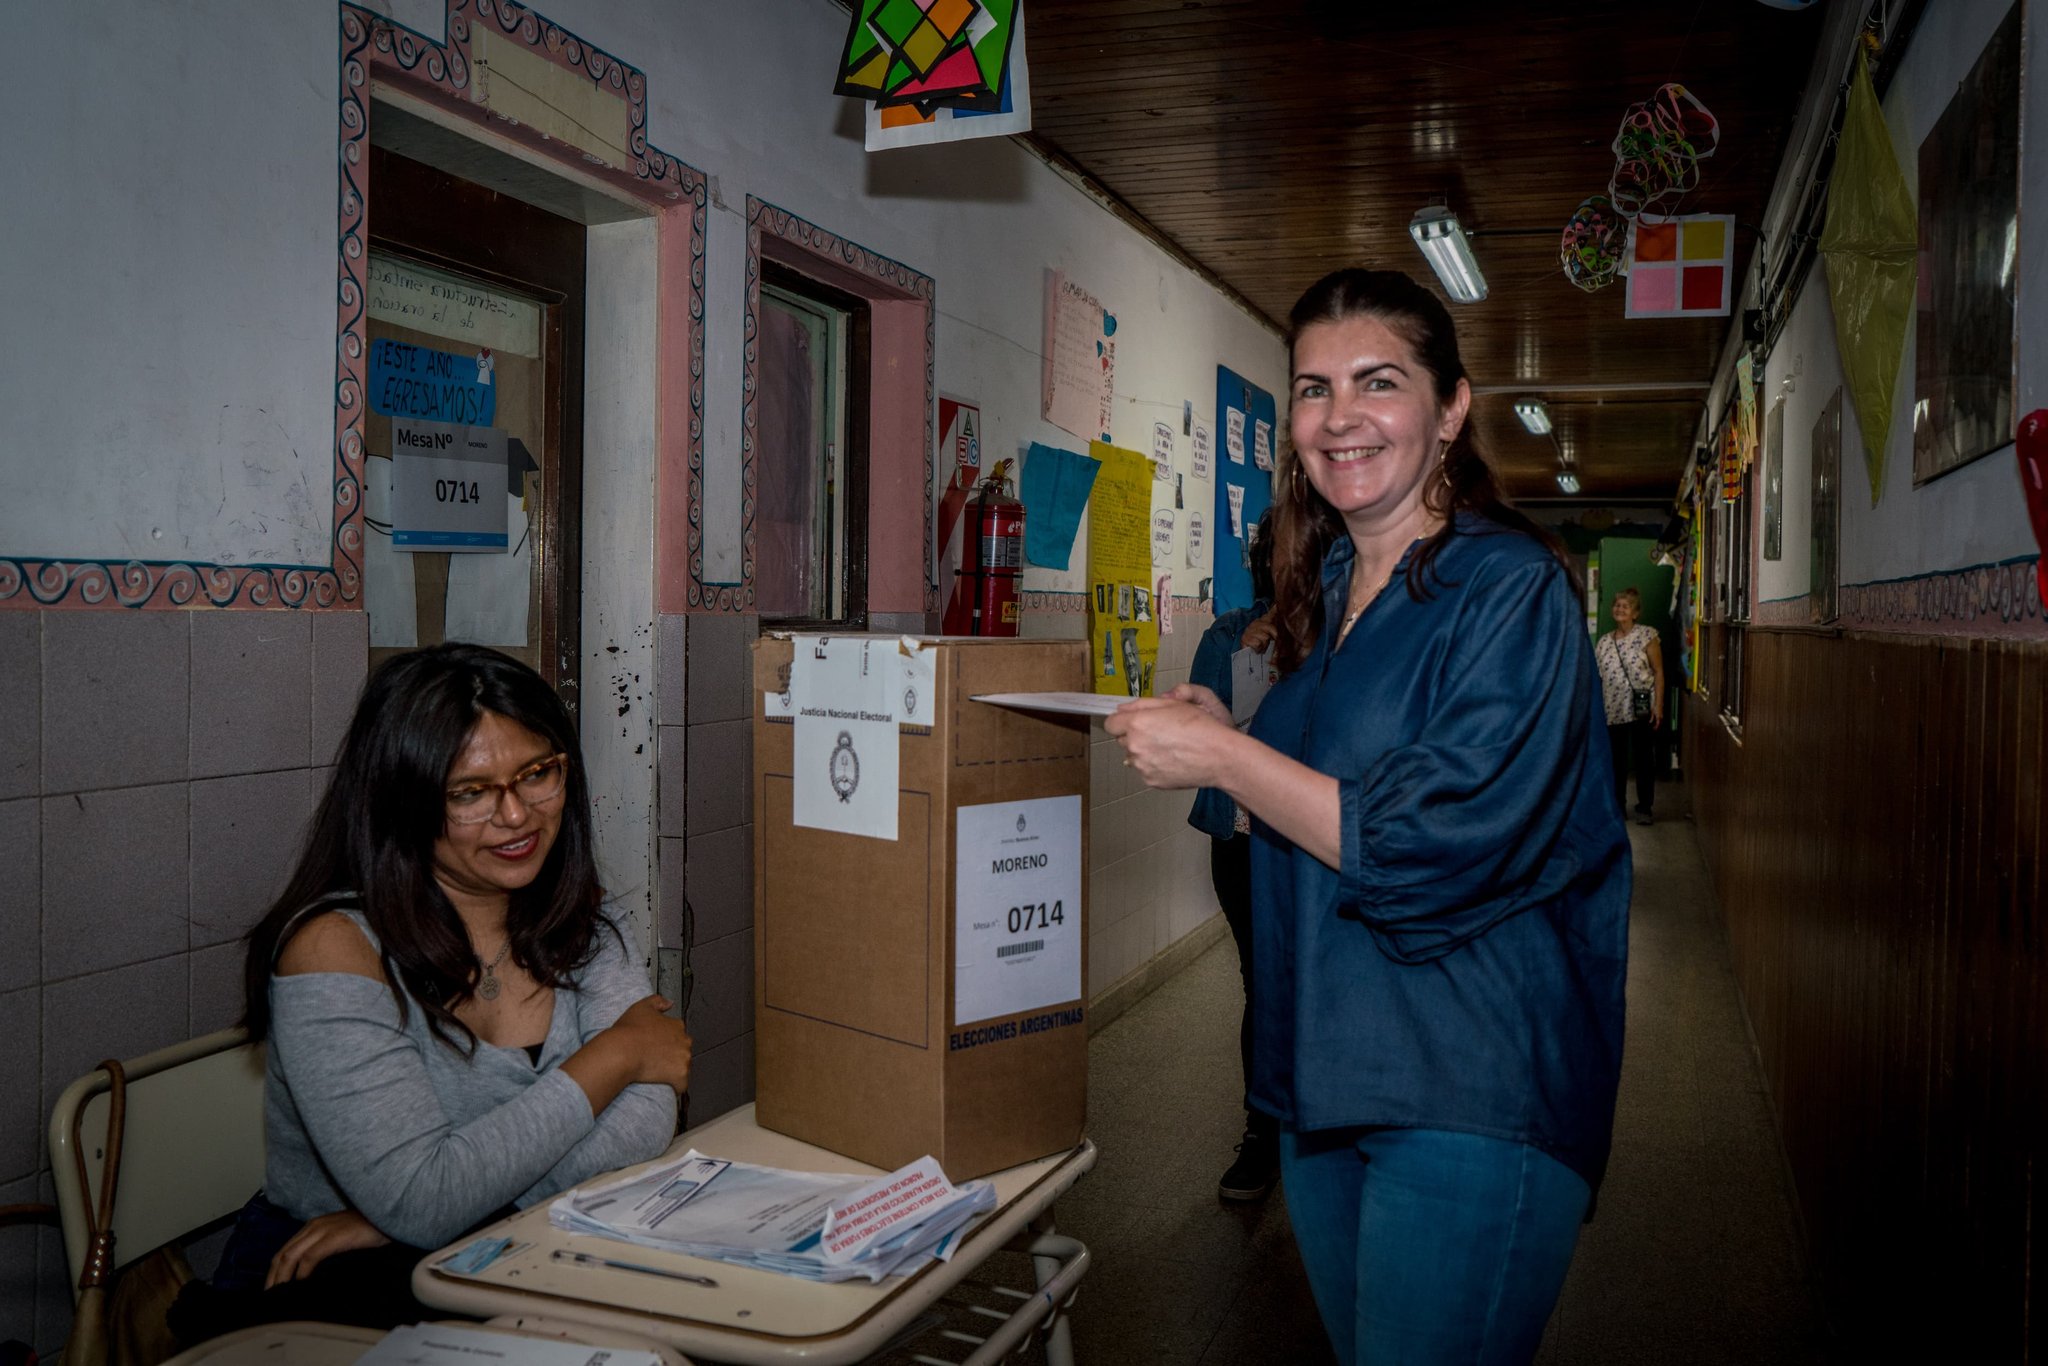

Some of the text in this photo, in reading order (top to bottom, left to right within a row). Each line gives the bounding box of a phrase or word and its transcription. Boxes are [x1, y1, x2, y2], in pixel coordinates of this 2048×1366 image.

[383, 377, 486, 424] EGRESAMOS!
[398, 429, 433, 448] Mesa
[436, 480, 480, 504] 0714
[800, 707, 892, 722] Justicia Nacional Electoral
[992, 853, 1048, 874] MORENO
[973, 922, 990, 931] Mesa
[1008, 900, 1064, 934] 0714
[950, 1007, 1084, 1052] ELECCIONES ARGENTINAS
[920, 1194, 935, 1206] MESA
[835, 1209, 847, 1220] MES
